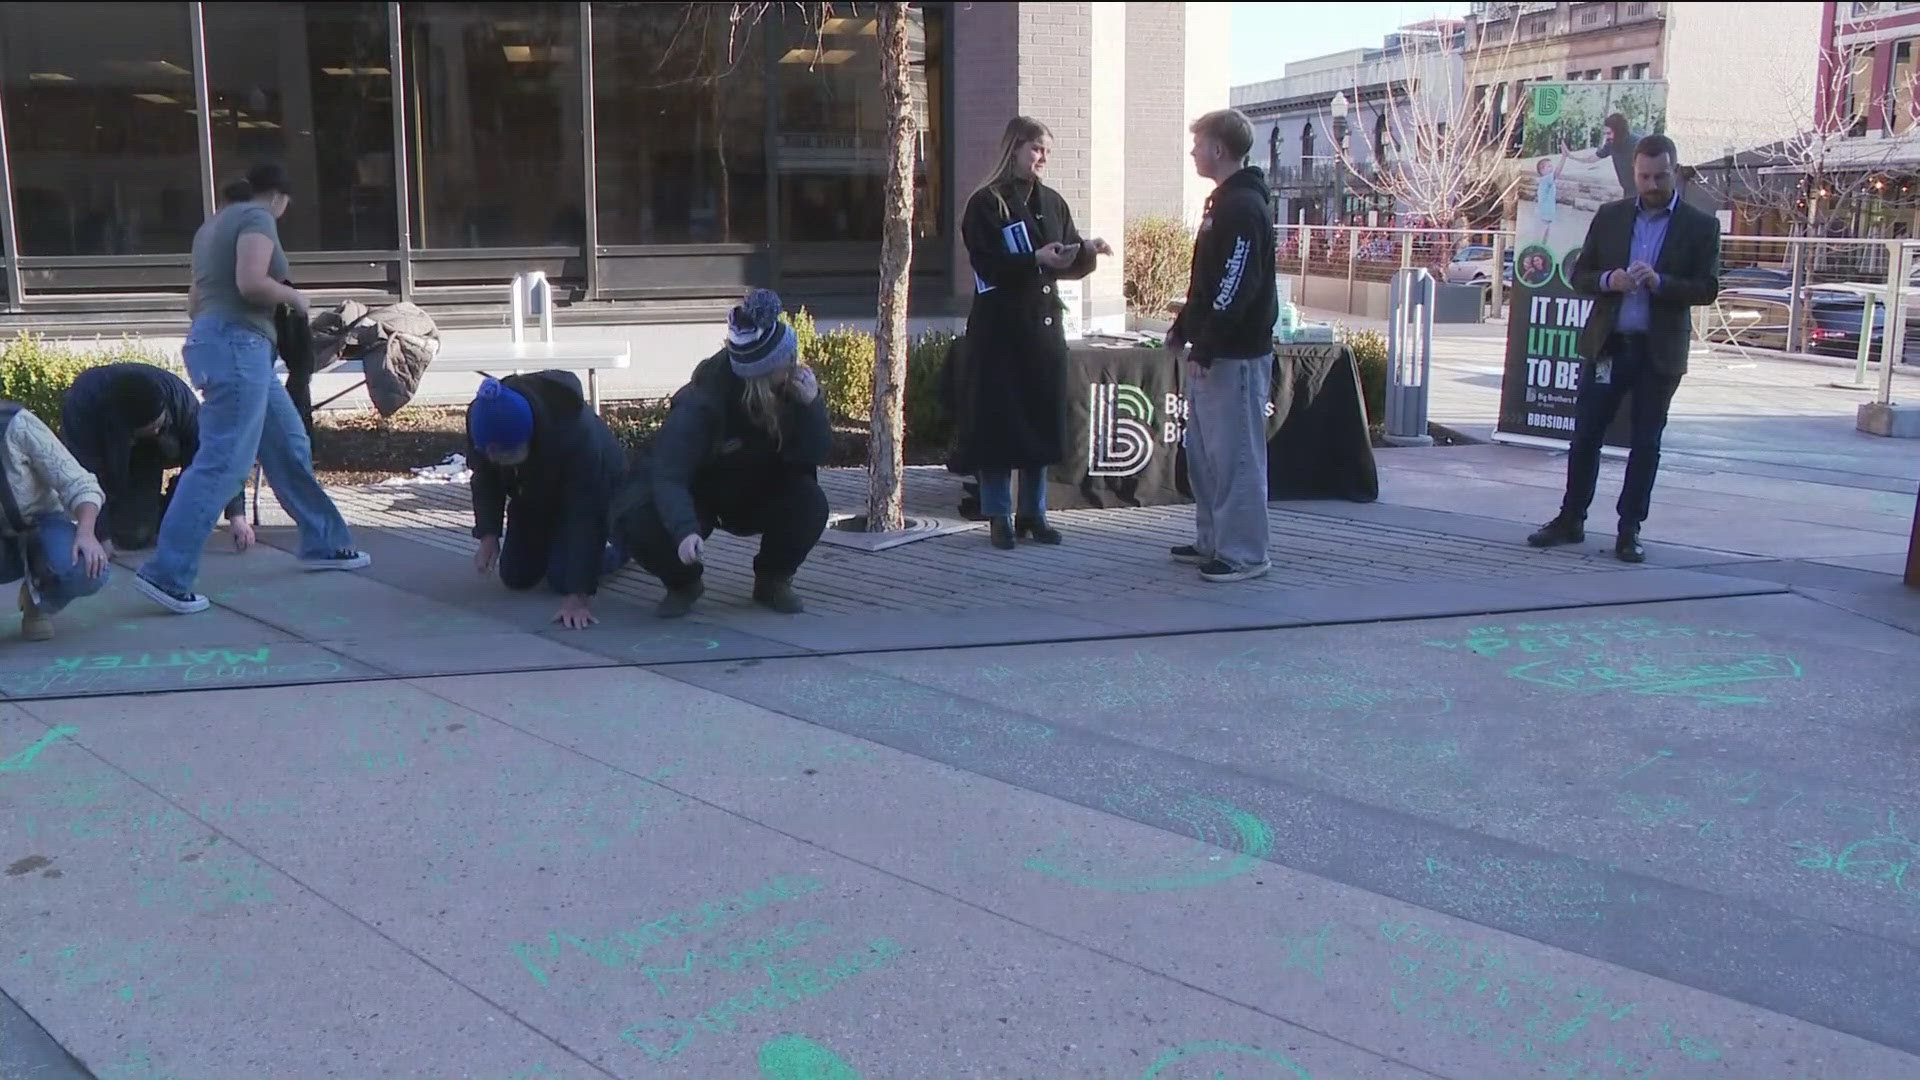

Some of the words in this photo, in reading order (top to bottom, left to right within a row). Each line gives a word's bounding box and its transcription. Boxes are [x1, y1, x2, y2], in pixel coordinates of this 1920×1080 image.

[1212, 235, 1246, 310] Quiksilver
[1530, 296, 1551, 325] IT
[1527, 327, 1587, 360] LITTL
[1526, 358, 1552, 387] TO
[1554, 361, 1580, 391] BE
